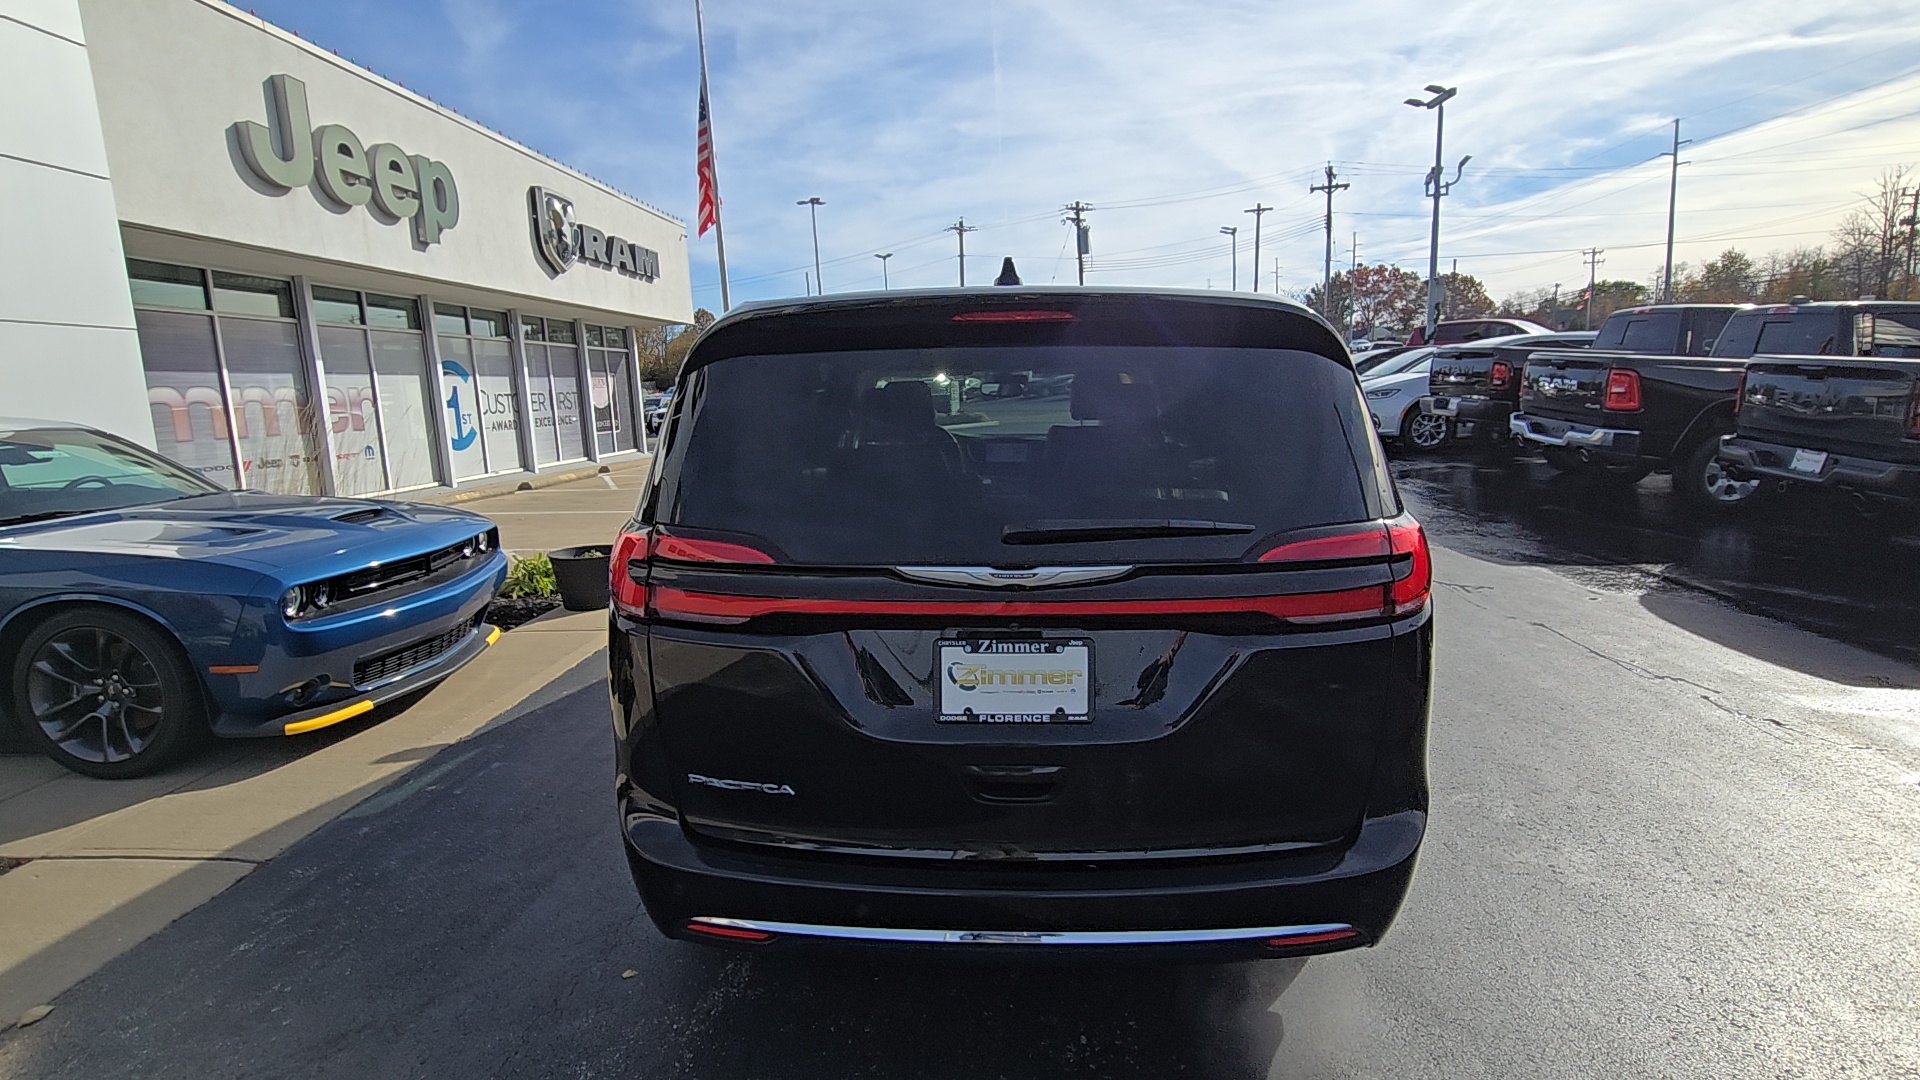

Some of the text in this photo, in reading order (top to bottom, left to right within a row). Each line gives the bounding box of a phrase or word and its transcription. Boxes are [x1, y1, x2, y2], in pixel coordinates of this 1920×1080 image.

[226, 74, 459, 245] Jeep
[578, 224, 661, 280] RAM
[479, 389, 548, 415] CUSTOER
[491, 419, 518, 432] AWARD
[977, 639, 1049, 653] Zimmer
[956, 663, 1083, 685] Zimmer
[978, 714, 1051, 723] FLORENCE
[687, 773, 796, 796] PACIFICA
